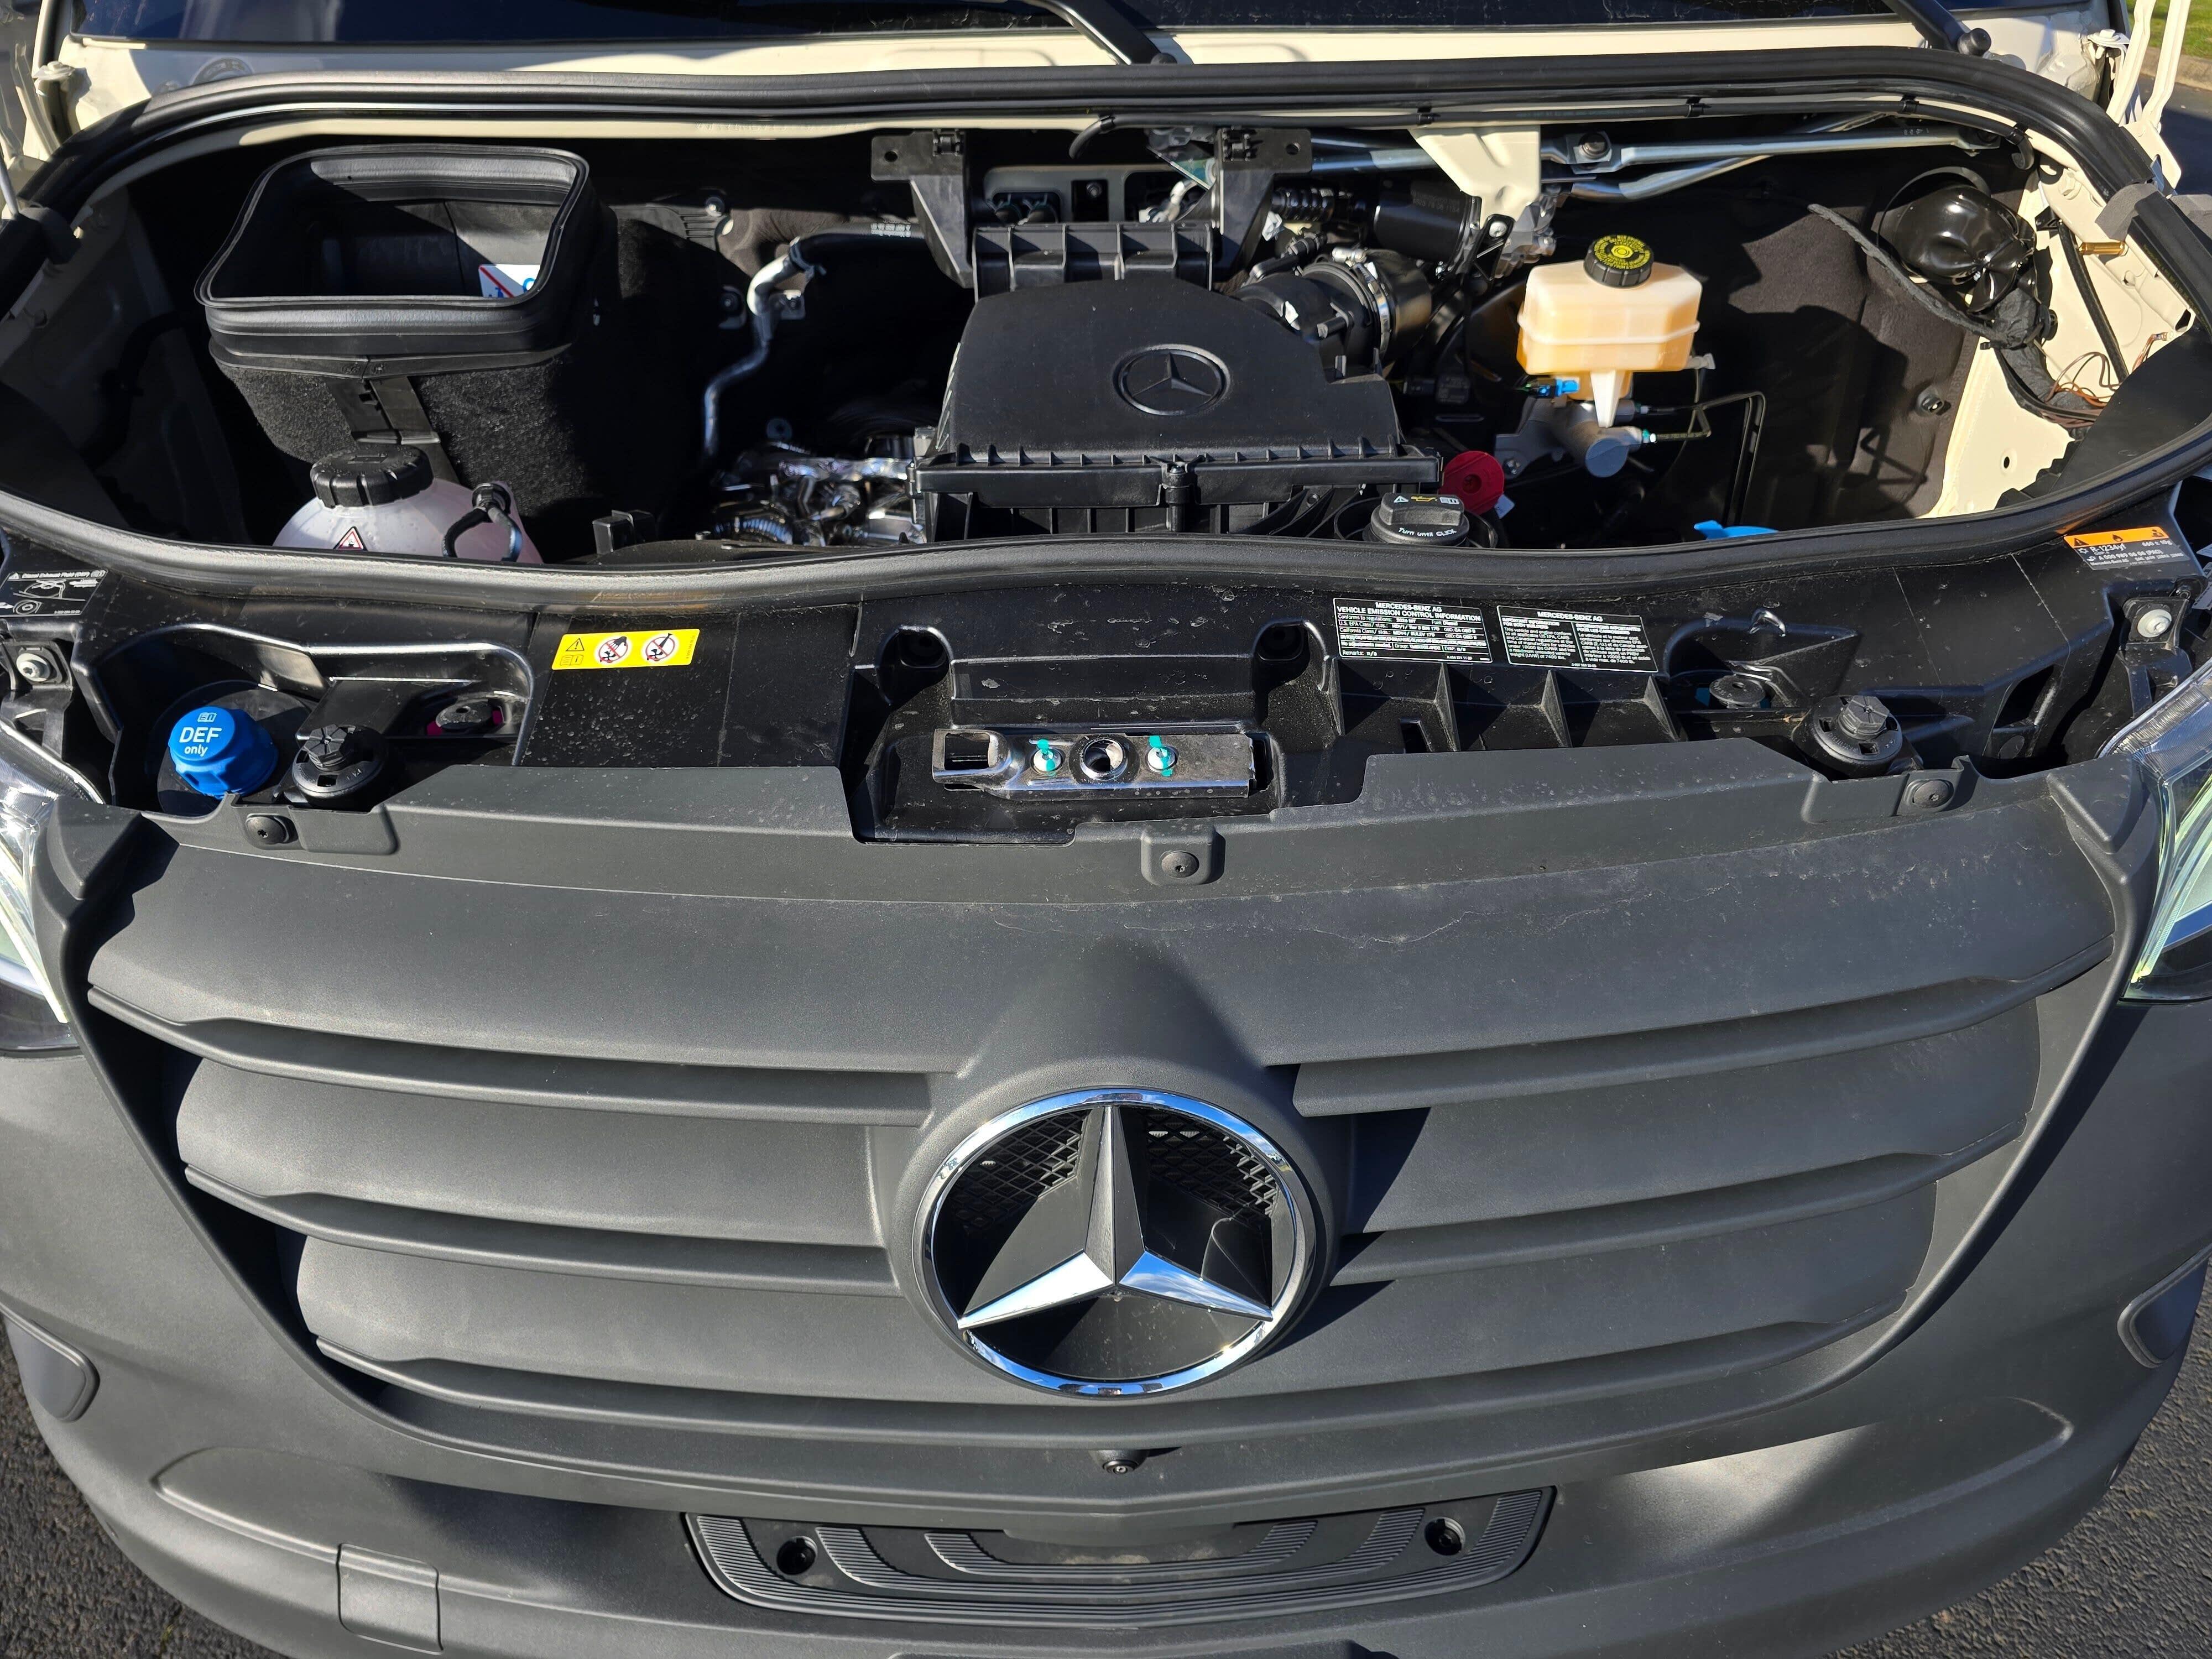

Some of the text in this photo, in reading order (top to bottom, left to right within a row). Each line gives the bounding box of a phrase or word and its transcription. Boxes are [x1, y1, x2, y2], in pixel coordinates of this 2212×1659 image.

[1399, 527, 1415, 535] Turn
[1436, 529, 1457, 537] CLICK
[2090, 543, 2127, 552] R-1234yf
[1375, 602, 1431, 611] MERCEDES-BENZ
[1434, 612, 1481, 620] INFORMATION
[1537, 612, 1592, 620] MERCEDES-BENZ
[179, 727, 222, 743] DEF
[184, 744, 208, 757] only
